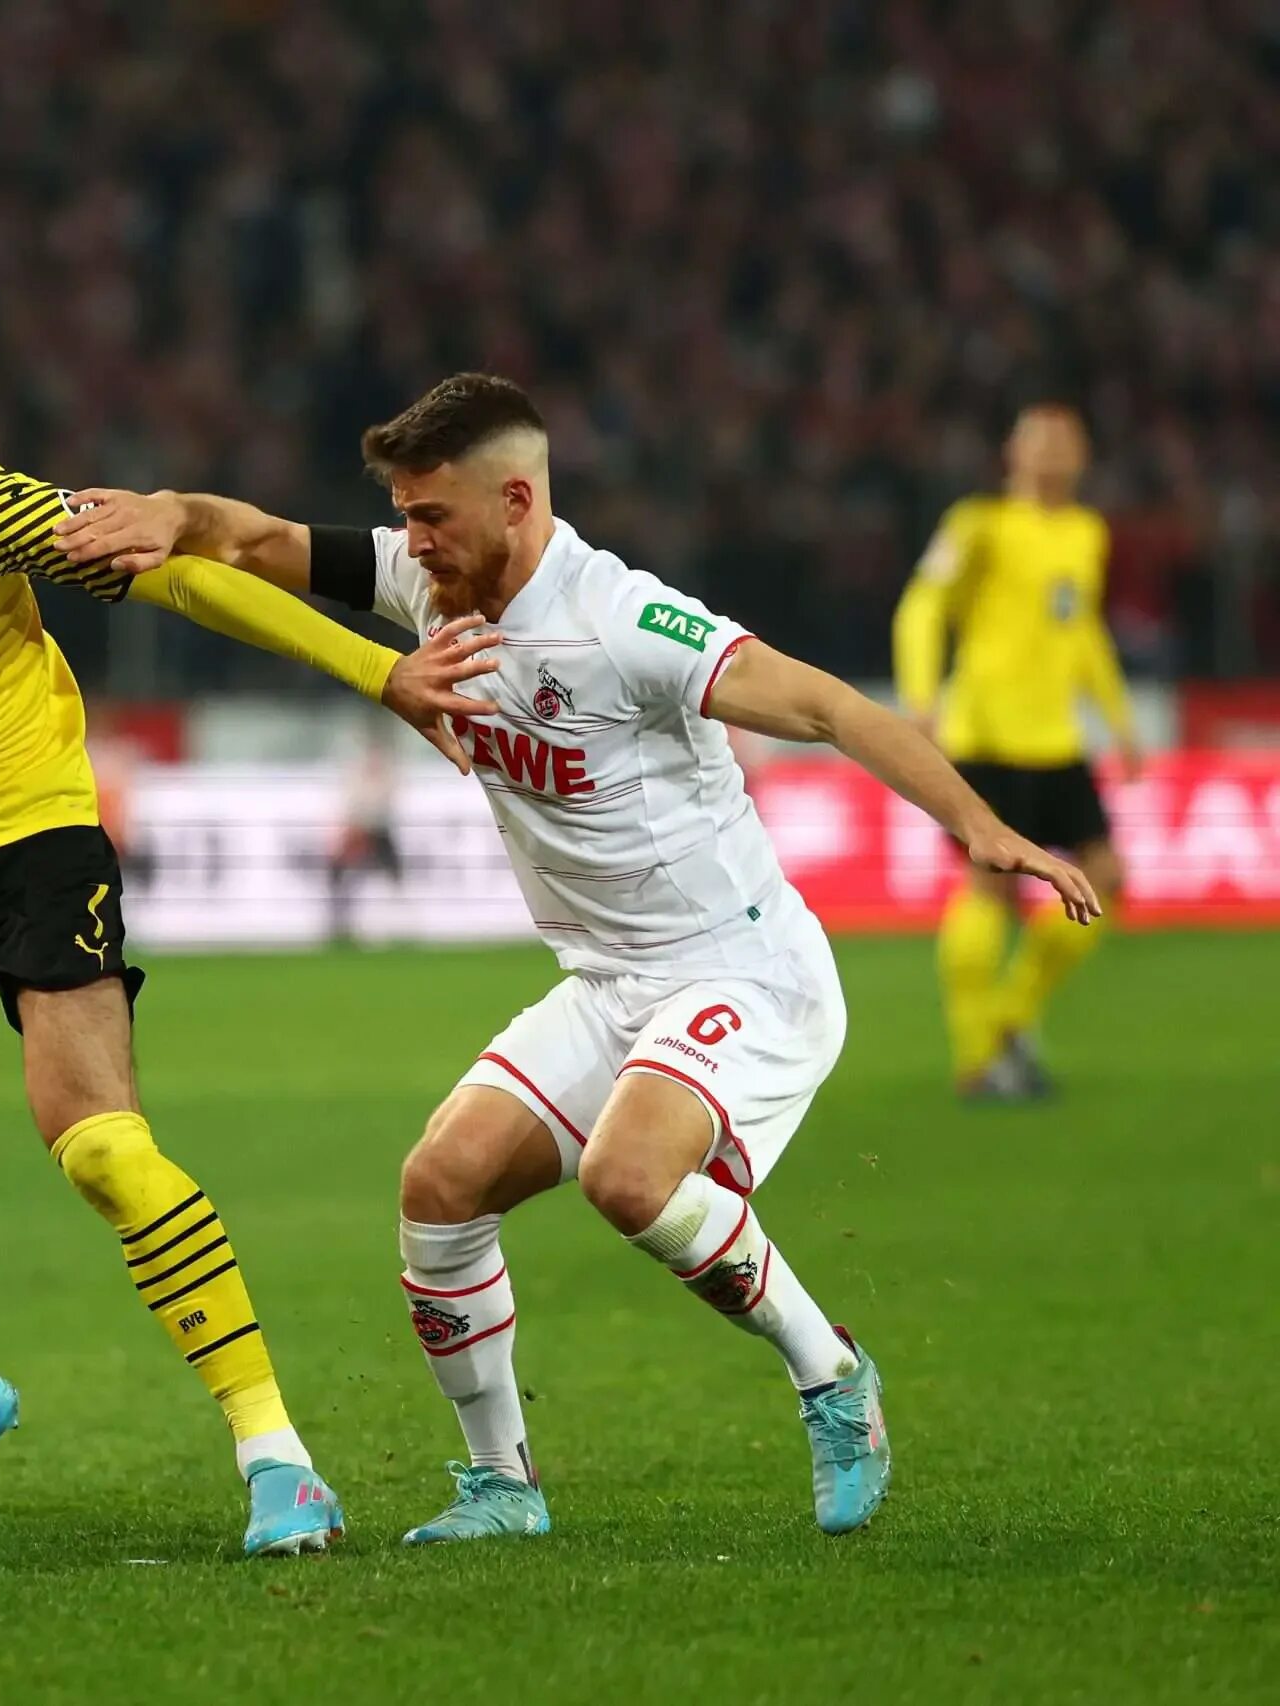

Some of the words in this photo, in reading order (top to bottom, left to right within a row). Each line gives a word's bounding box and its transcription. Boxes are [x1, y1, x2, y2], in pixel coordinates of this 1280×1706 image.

[452, 715, 595, 795] EWE
[686, 1004, 741, 1045] 6
[654, 1036, 720, 1073] uhlsport
[178, 1310, 207, 1333] BVB
